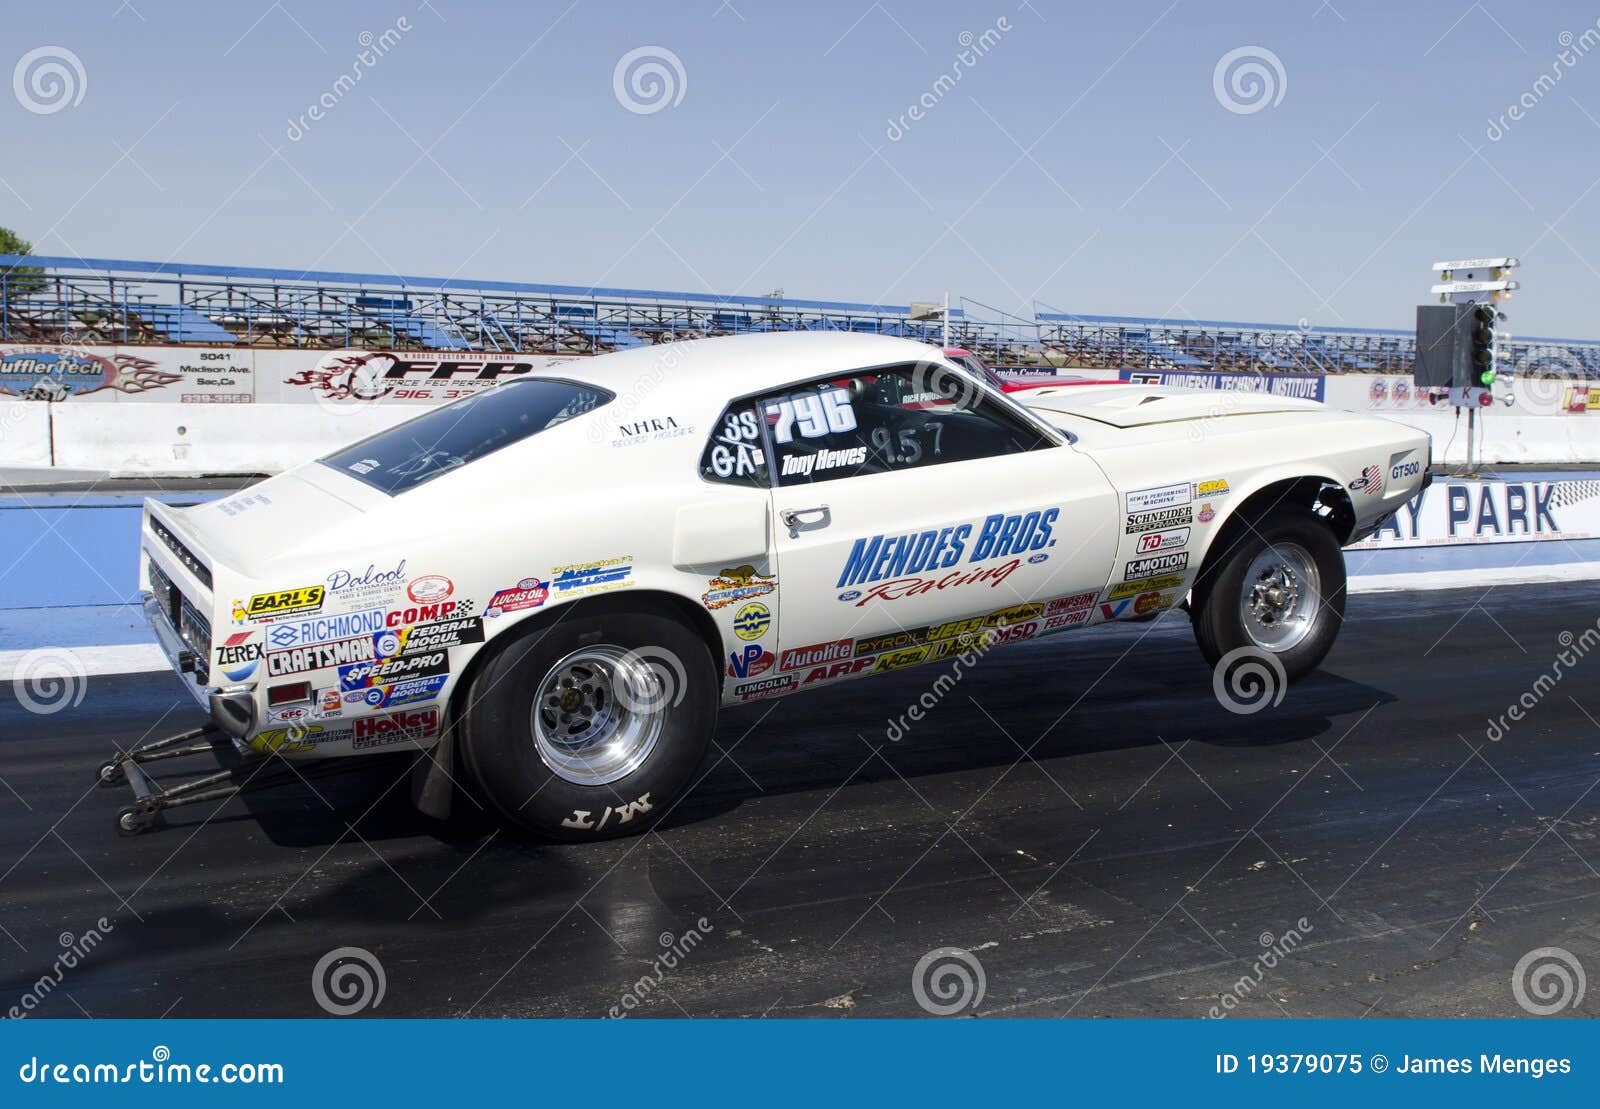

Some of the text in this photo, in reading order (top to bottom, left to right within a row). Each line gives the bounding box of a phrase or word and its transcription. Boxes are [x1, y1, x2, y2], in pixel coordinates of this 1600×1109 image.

[0, 359, 104, 374] ufflerTech
[200, 353, 231, 361] 5041
[228, 366, 252, 374] Ave.
[197, 378, 236, 387] Sac,Ca
[1164, 374, 1218, 389] UNIVERSAL
[1220, 376, 1270, 394] TECHNICAL
[1271, 377, 1319, 398] INSTITUTE
[619, 416, 678, 437] NHRA
[766, 388, 858, 444] 796
[782, 452, 815, 476] Tony
[815, 446, 867, 470] Hewes
[1392, 461, 1419, 479] GT500
[1127, 507, 1192, 526] SCHNEIDER
[1448, 484, 1560, 537] PARK
[1128, 515, 1192, 533] PERFORMANCE
[836, 507, 1060, 588] MENDES BROS.
[1128, 553, 1187, 574] K-MOTION
[855, 558, 1022, 607] Racing
[251, 588, 320, 611] EARL'S
[493, 591, 528, 607] LUCAS
[528, 588, 543, 600] OIL
[1047, 593, 1096, 611] SIMPSON
[386, 601, 456, 628] COMP
[435, 610, 469, 622] CAMS
[301, 611, 383, 643] RICHMOND
[410, 618, 477, 639] FEDERAL
[993, 622, 1038, 643] MSD
[405, 631, 459, 650] MOGUL
[855, 632, 925, 655] PYROIL
[216, 642, 266, 666] ZEREX
[268, 637, 375, 676] CRAFTSMAN
[730, 644, 763, 679] VP
[783, 643, 850, 669] Autolite
[346, 652, 445, 681] SPEED-PRO
[805, 656, 876, 683] ARP
[390, 686, 428, 699] MOGUL
[393, 677, 441, 692] FEDERAL
[738, 677, 789, 694] LINCOLN
[356, 710, 437, 737] Holley
